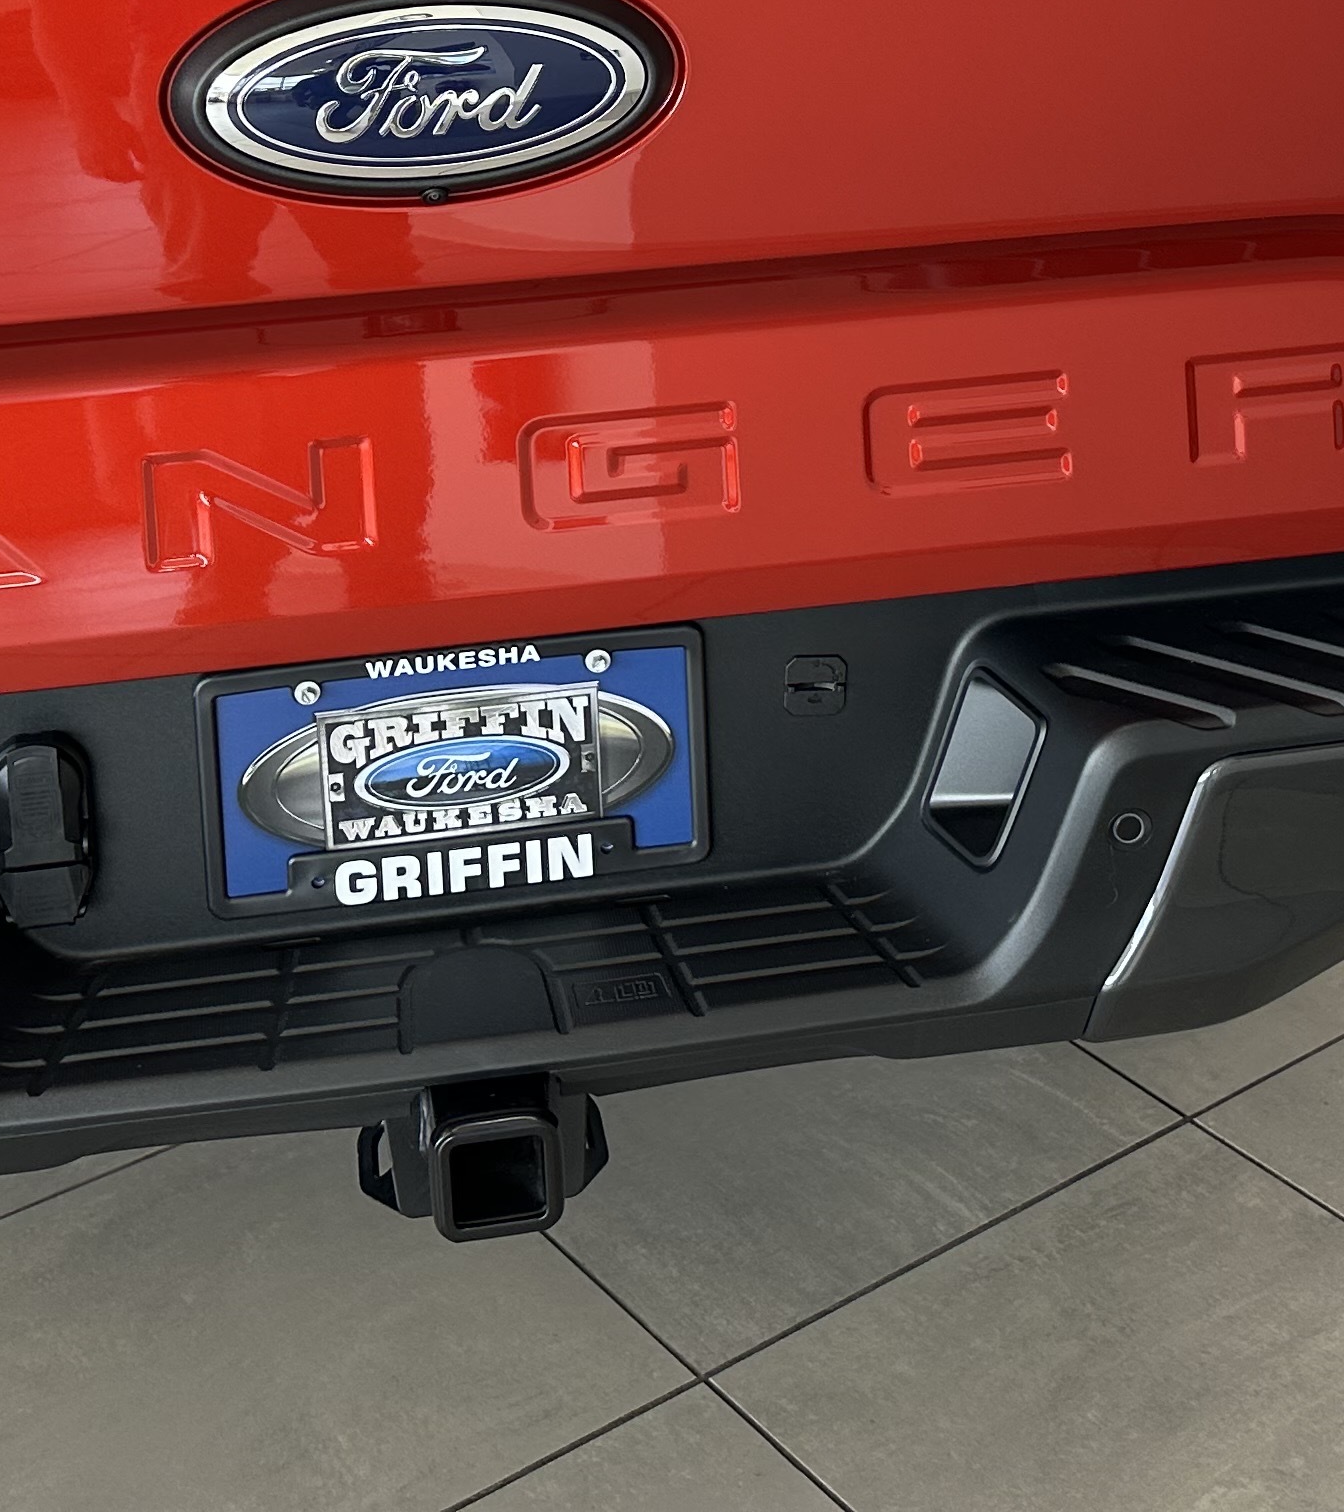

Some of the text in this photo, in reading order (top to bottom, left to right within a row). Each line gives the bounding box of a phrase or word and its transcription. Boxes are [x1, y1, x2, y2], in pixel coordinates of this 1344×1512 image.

[316, 45, 544, 145] Ford
[365, 644, 541, 680] WAUKESHA
[329, 696, 590, 769] GRIFFIN
[405, 751, 519, 798] Ford
[338, 792, 588, 841] WAUKESHA
[333, 833, 595, 906] GRIFFIN
